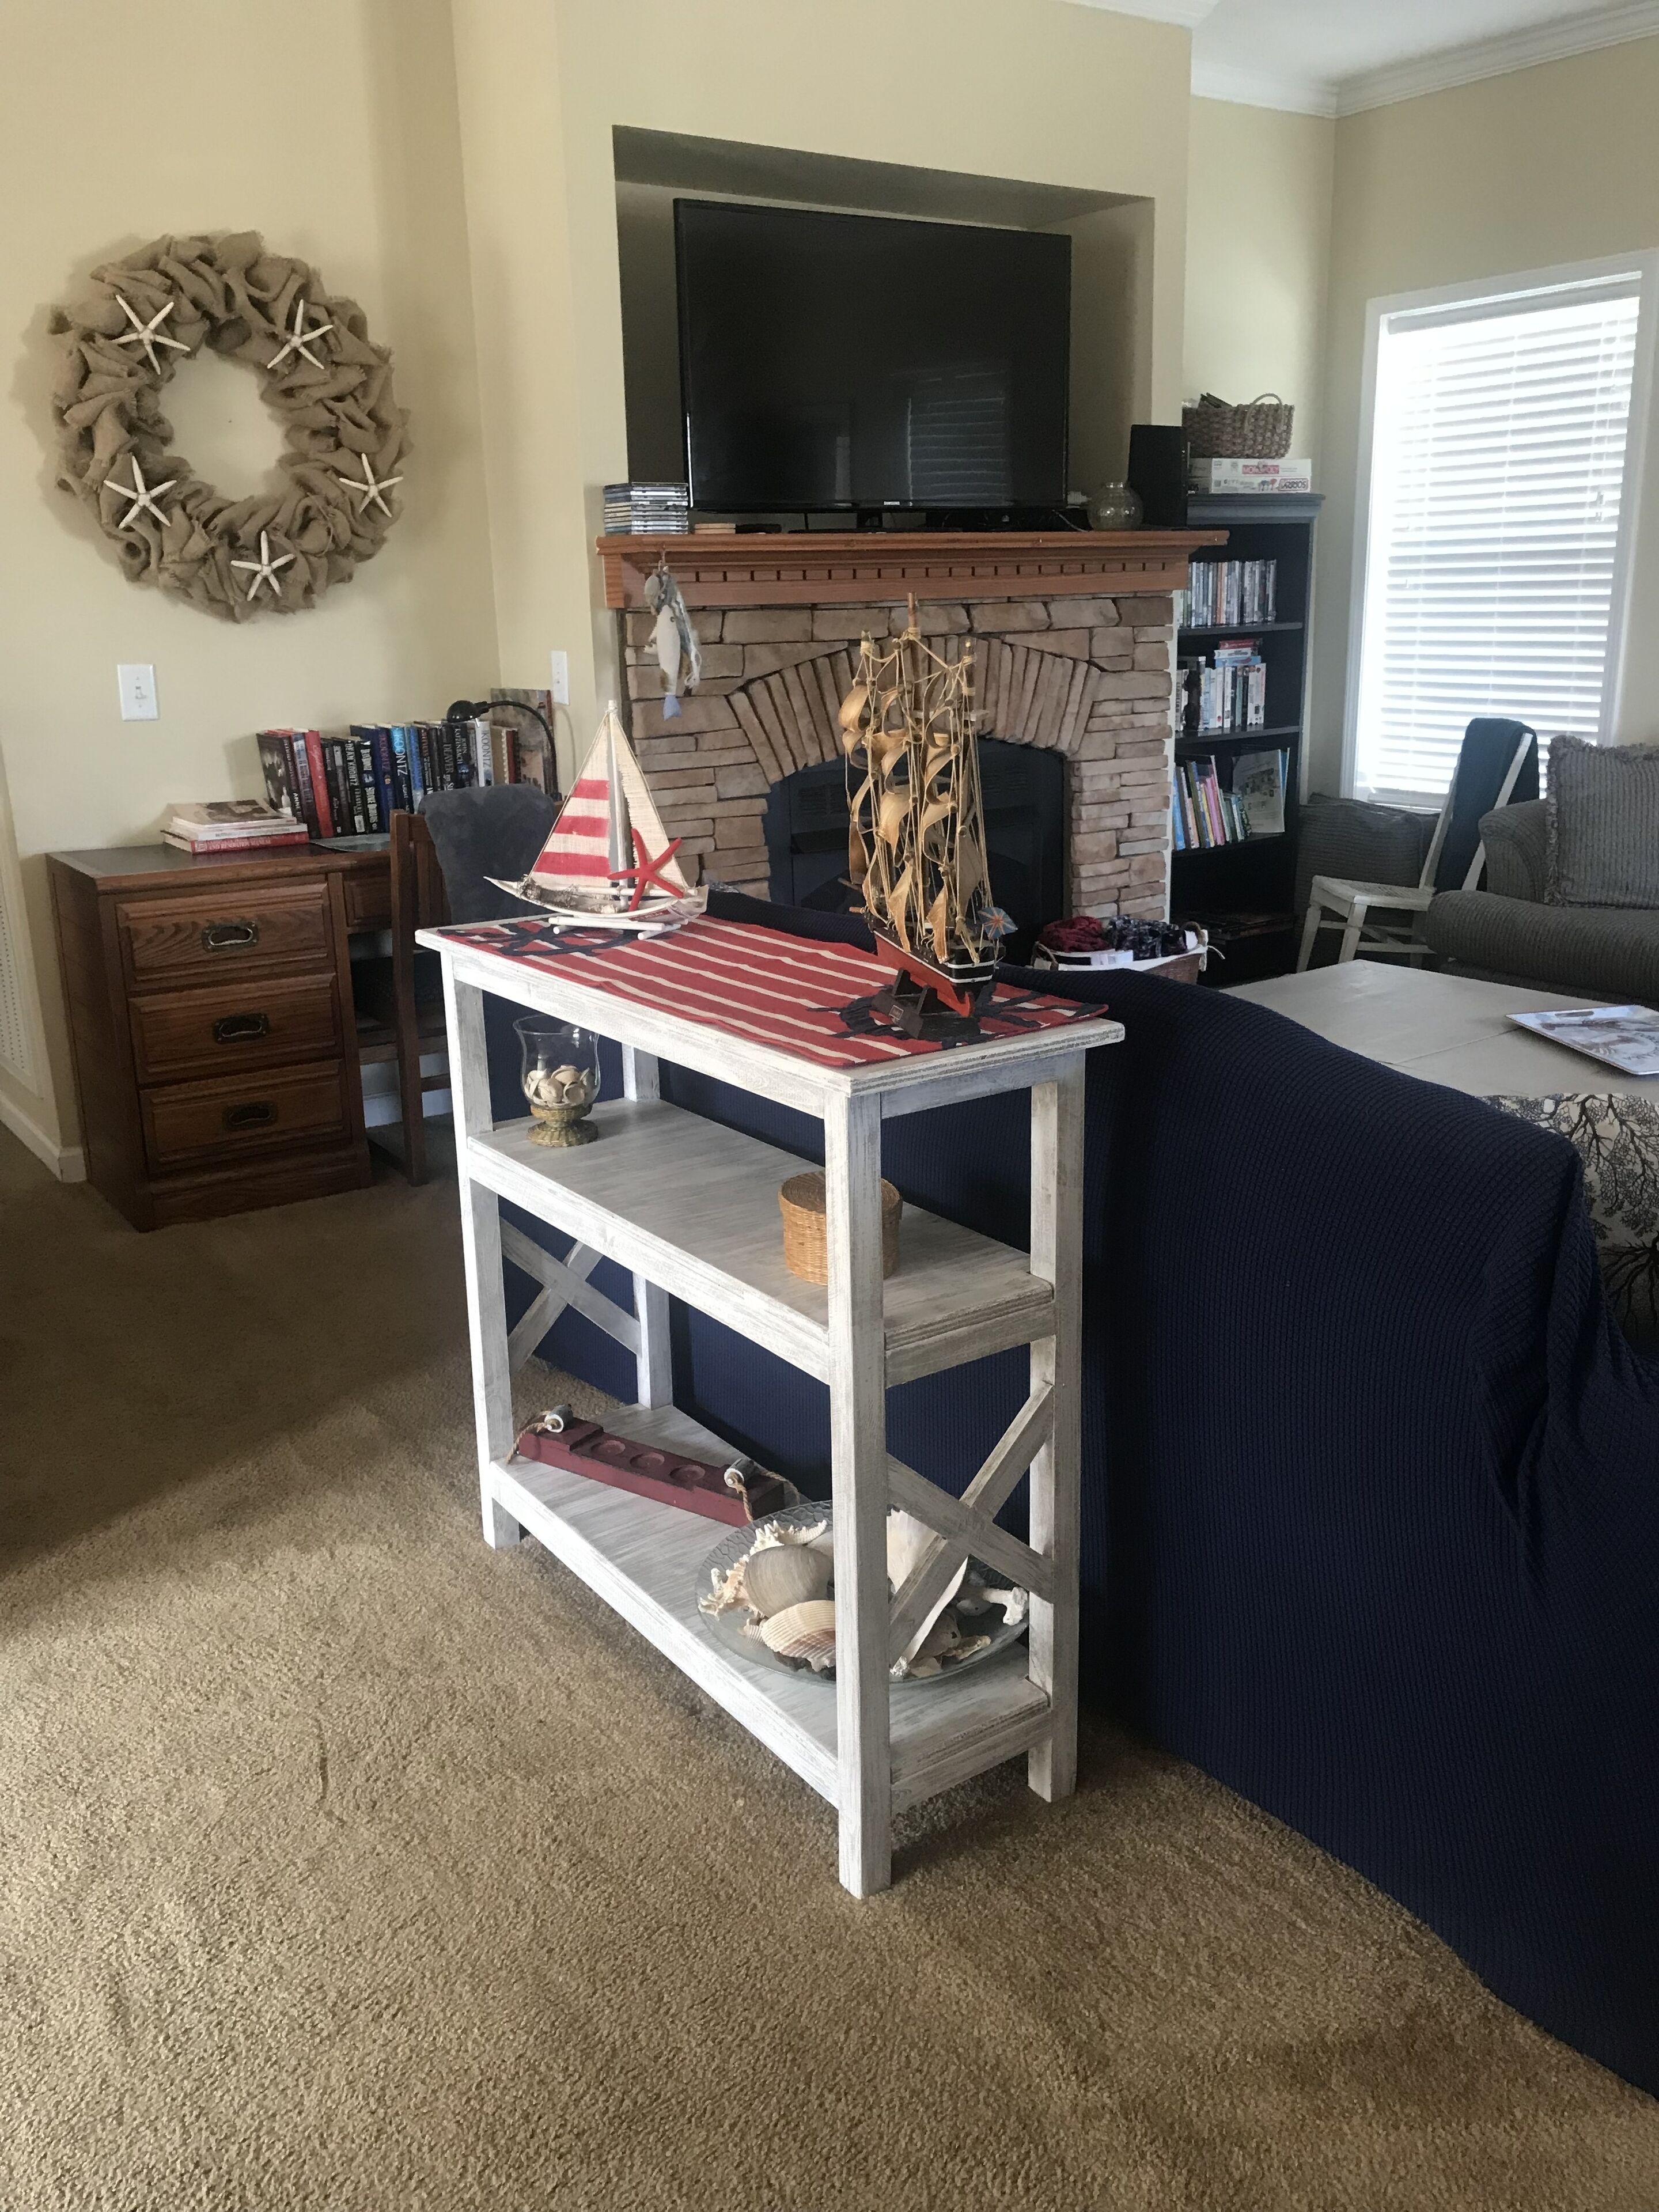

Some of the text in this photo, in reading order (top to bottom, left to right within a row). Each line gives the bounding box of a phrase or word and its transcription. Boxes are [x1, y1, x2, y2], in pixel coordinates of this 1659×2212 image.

[346, 743, 356, 762] DEAN
[379, 733, 390, 770] KOONTZ
[394, 733, 408, 777] KOONTZ
[443, 744, 454, 772] DEAVER
[454, 728, 463, 764] KATZENBACH
[481, 729, 491, 767] KOONTZ
[348, 762, 359, 786] KOONTZ
